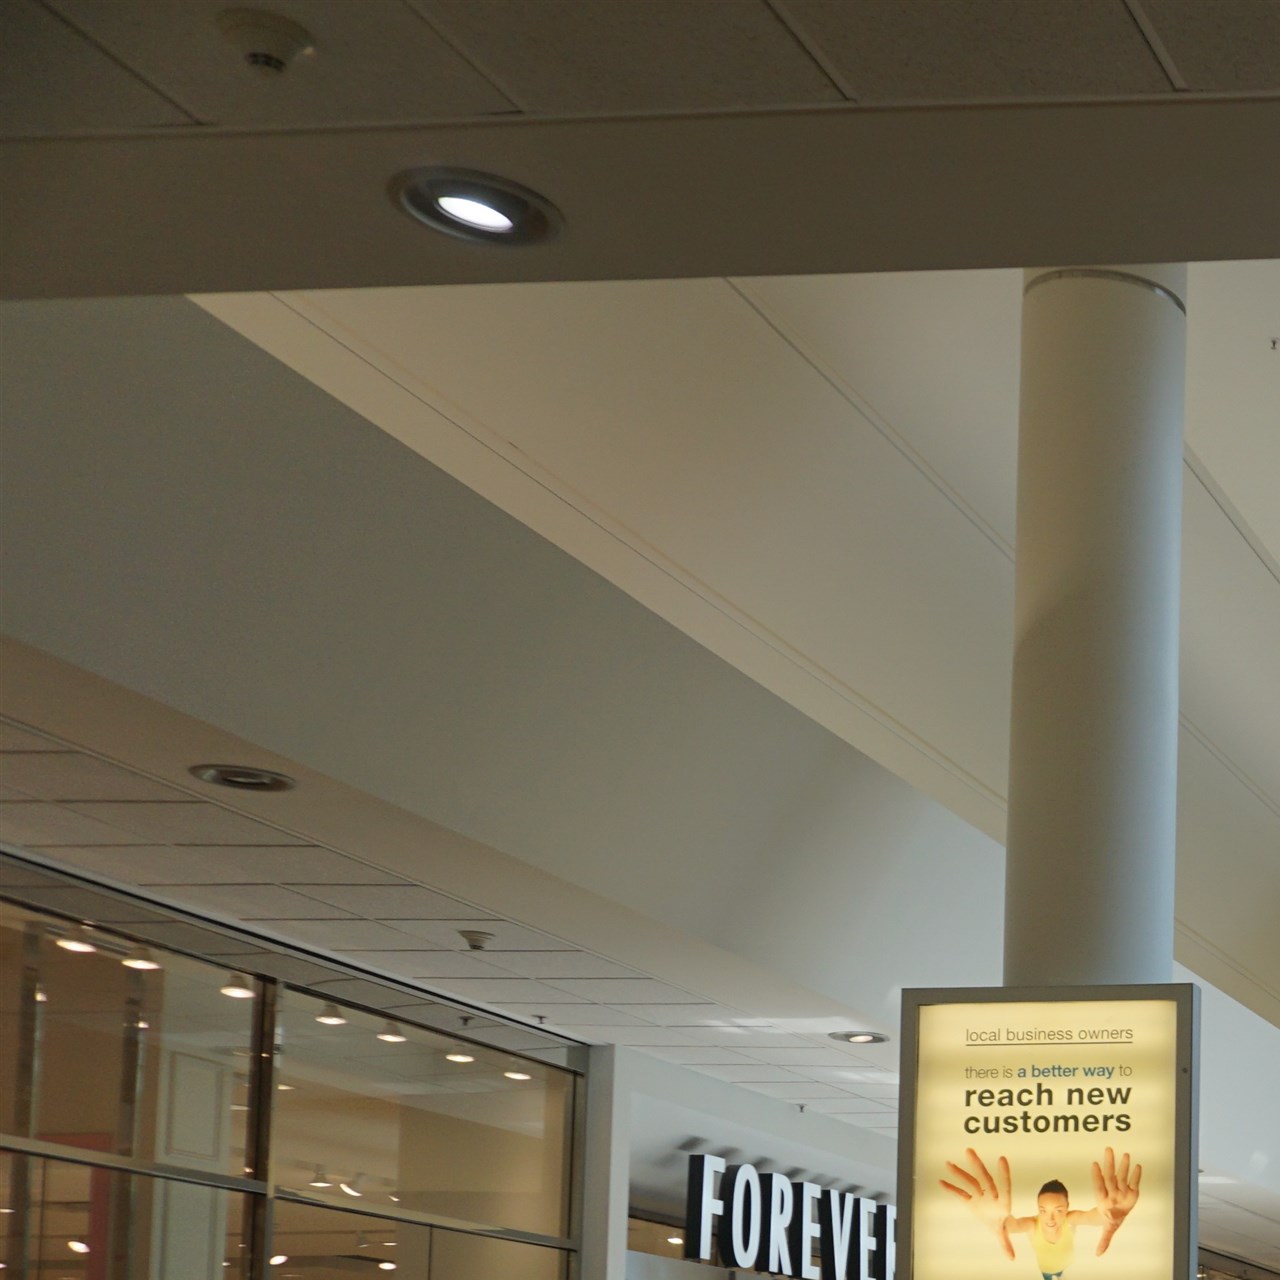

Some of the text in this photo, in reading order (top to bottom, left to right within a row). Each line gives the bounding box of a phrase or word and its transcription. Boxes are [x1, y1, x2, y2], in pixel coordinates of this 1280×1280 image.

[966, 1027, 1133, 1042] local business owners
[965, 1064, 1133, 1080] there is a better way to
[965, 1082, 1132, 1107] reach new
[964, 1111, 1132, 1134] customers
